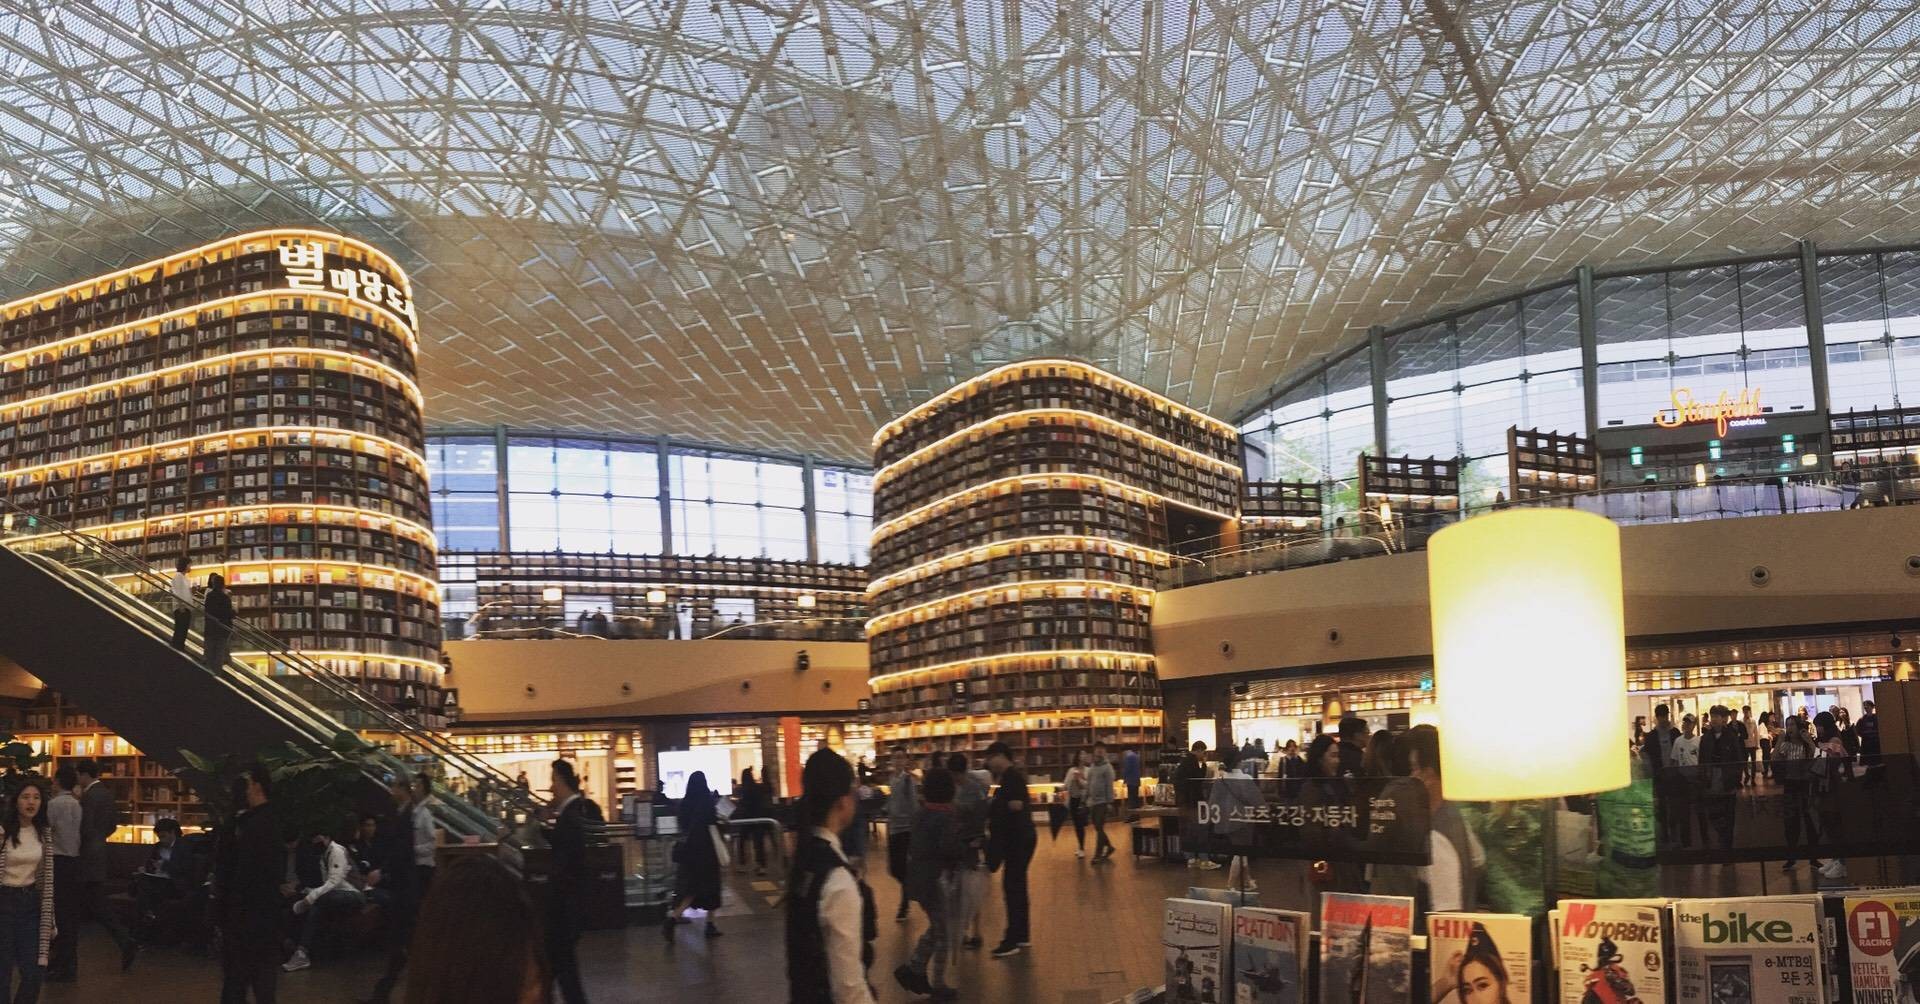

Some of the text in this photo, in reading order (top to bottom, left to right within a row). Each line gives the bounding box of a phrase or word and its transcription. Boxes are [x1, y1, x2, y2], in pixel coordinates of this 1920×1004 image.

[405, 684, 415, 699] A
[444, 691, 456, 705] A
[1197, 801, 1221, 825] D3
[1679, 912, 1702, 924] the
[1702, 911, 1793, 944] bike
[1857, 911, 1890, 938] F1
[1859, 938, 1892, 948] RACING
[1764, 955, 1813, 971] e-MTB의
[1852, 962, 1880, 976] VETTEL
[1780, 971, 1815, 986] 모든 것
[1854, 988, 1893, 1004] WINNER
